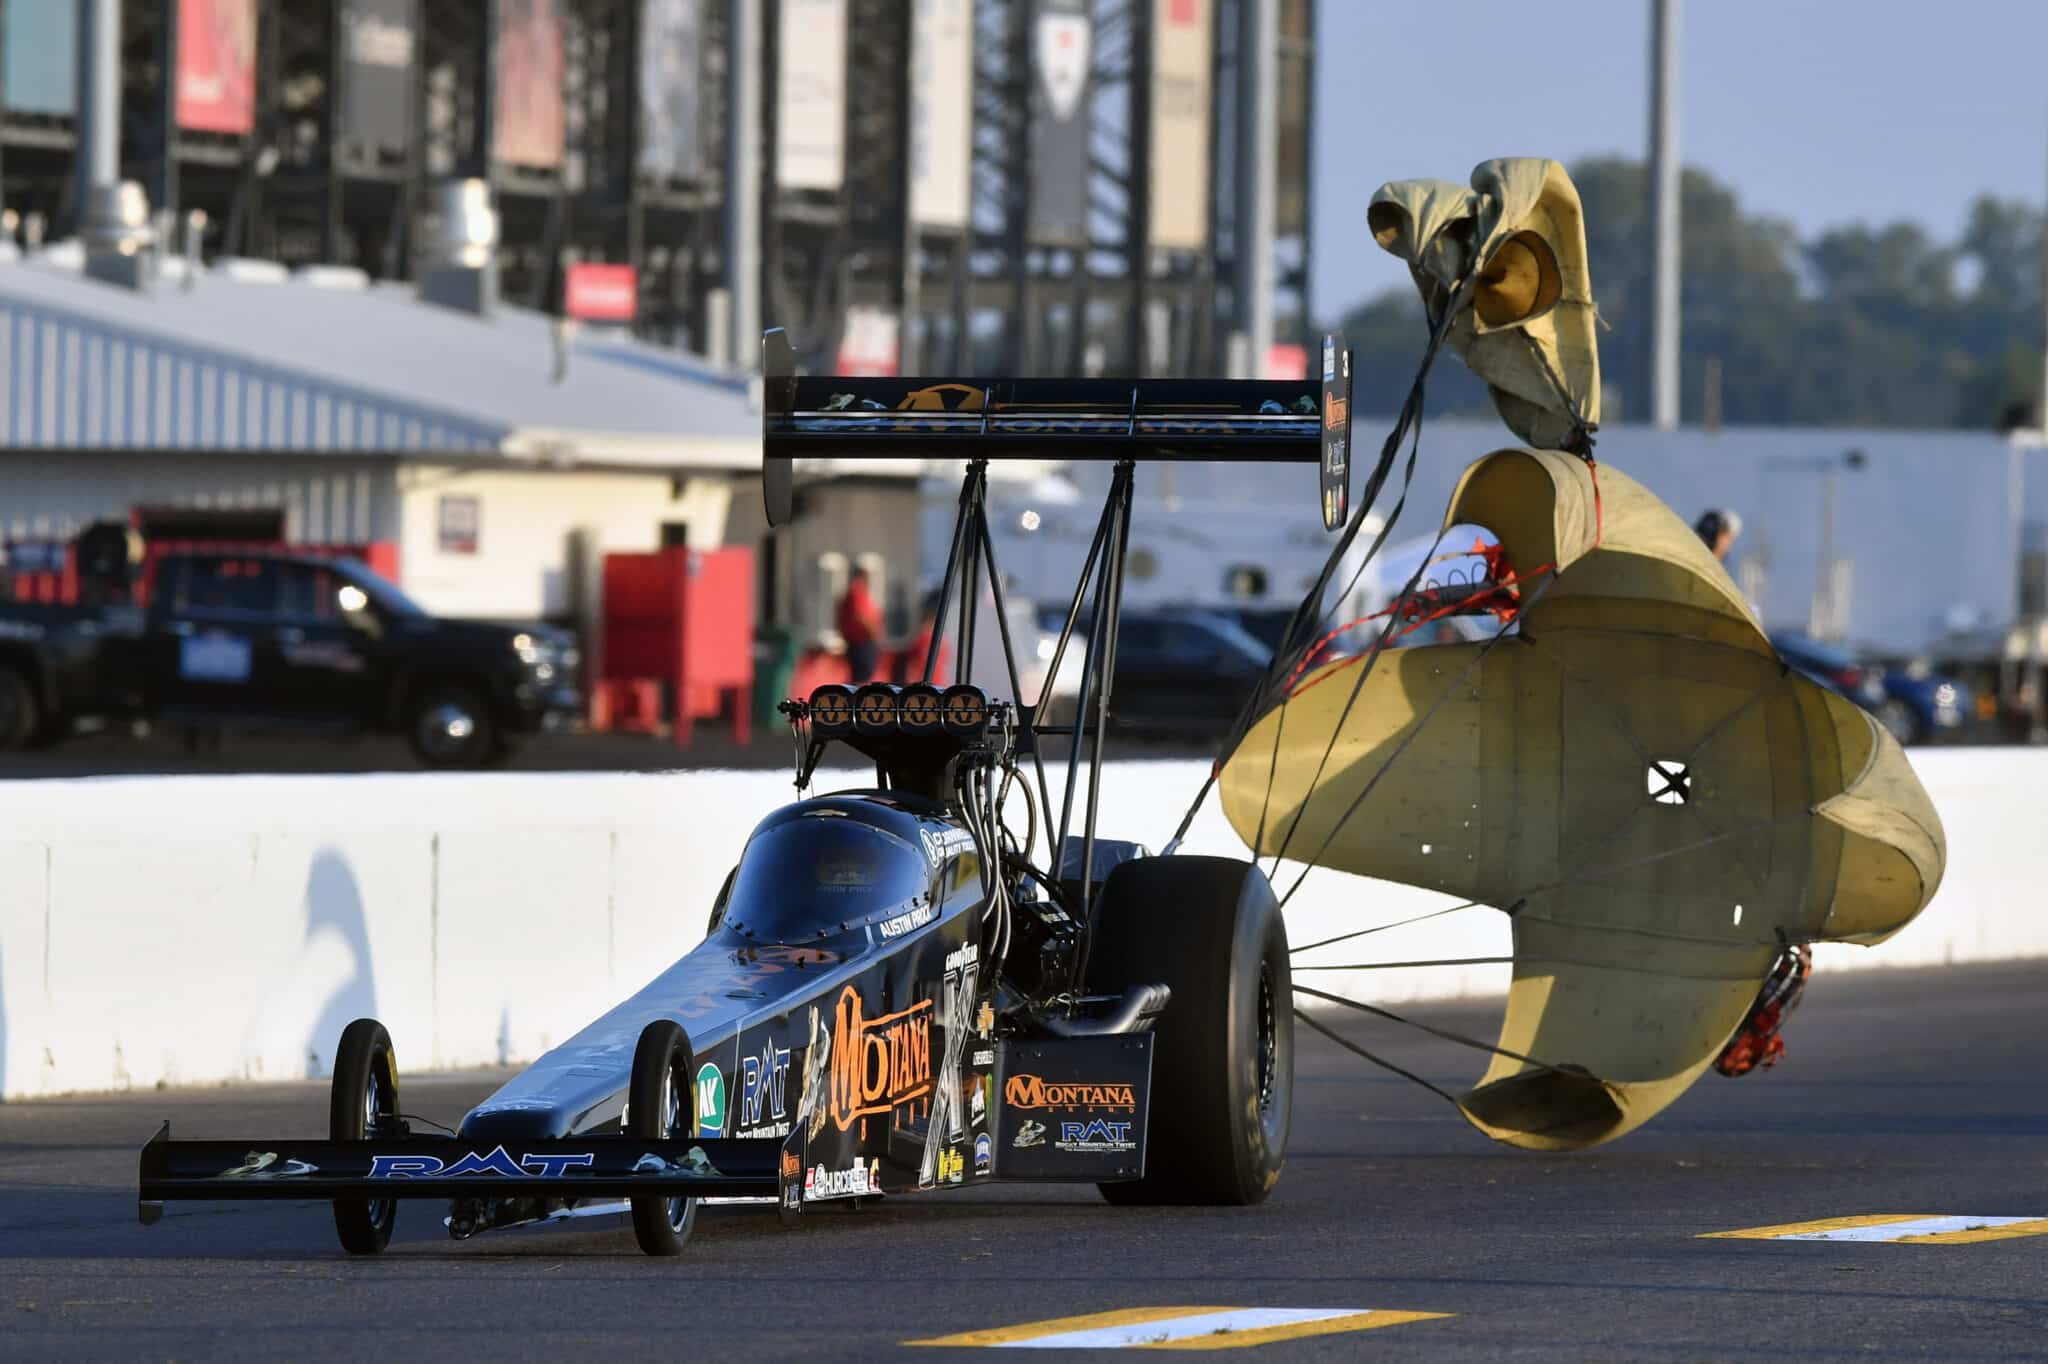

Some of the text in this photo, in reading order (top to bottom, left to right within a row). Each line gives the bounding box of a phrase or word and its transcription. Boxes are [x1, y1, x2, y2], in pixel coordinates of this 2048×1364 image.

[880, 913, 913, 938] AUSTIN
[831, 986, 932, 1130] MOTANA
[741, 1036, 790, 1126] RMT
[1005, 1074, 1136, 1109] MONTANA
[1061, 1118, 1131, 1142] RMT
[368, 1144, 594, 1178] RMT
